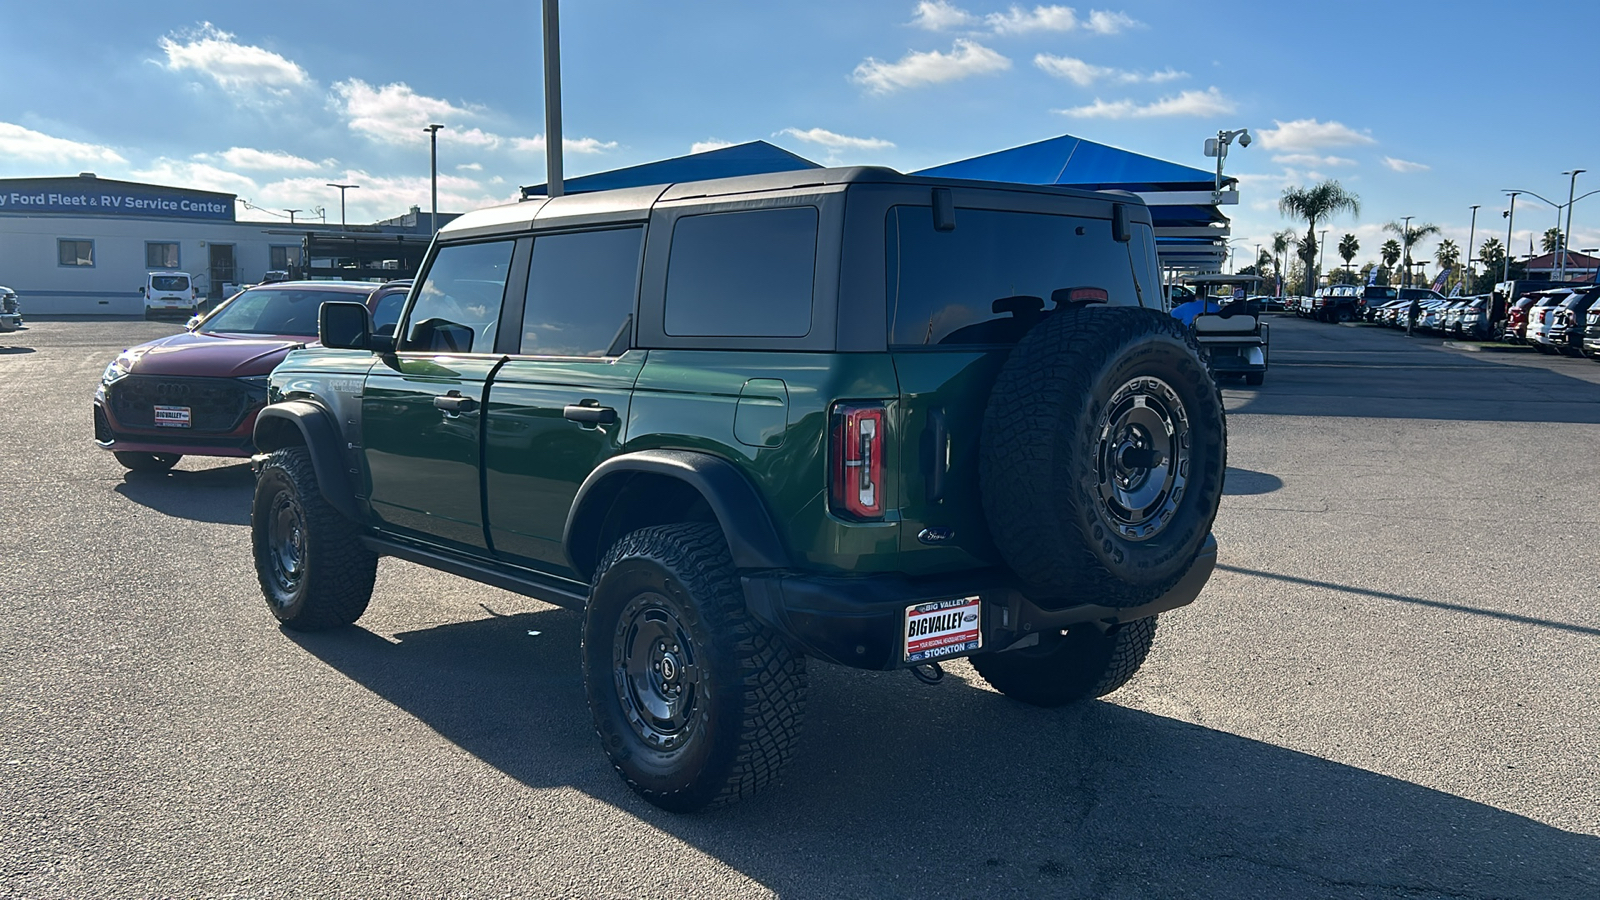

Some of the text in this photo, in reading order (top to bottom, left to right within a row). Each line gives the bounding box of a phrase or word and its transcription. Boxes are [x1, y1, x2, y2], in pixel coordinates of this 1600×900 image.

[10, 193, 45, 205] Ford
[48, 193, 87, 206] Fleet
[89, 197, 97, 206] &
[101, 195, 122, 207] RV
[125, 197, 178, 210] Service
[180, 200, 227, 213] Center
[925, 599, 965, 611] BIG VALLEY
[908, 611, 964, 638] BIGVALLEY
[924, 643, 965, 659] STOCKTON
